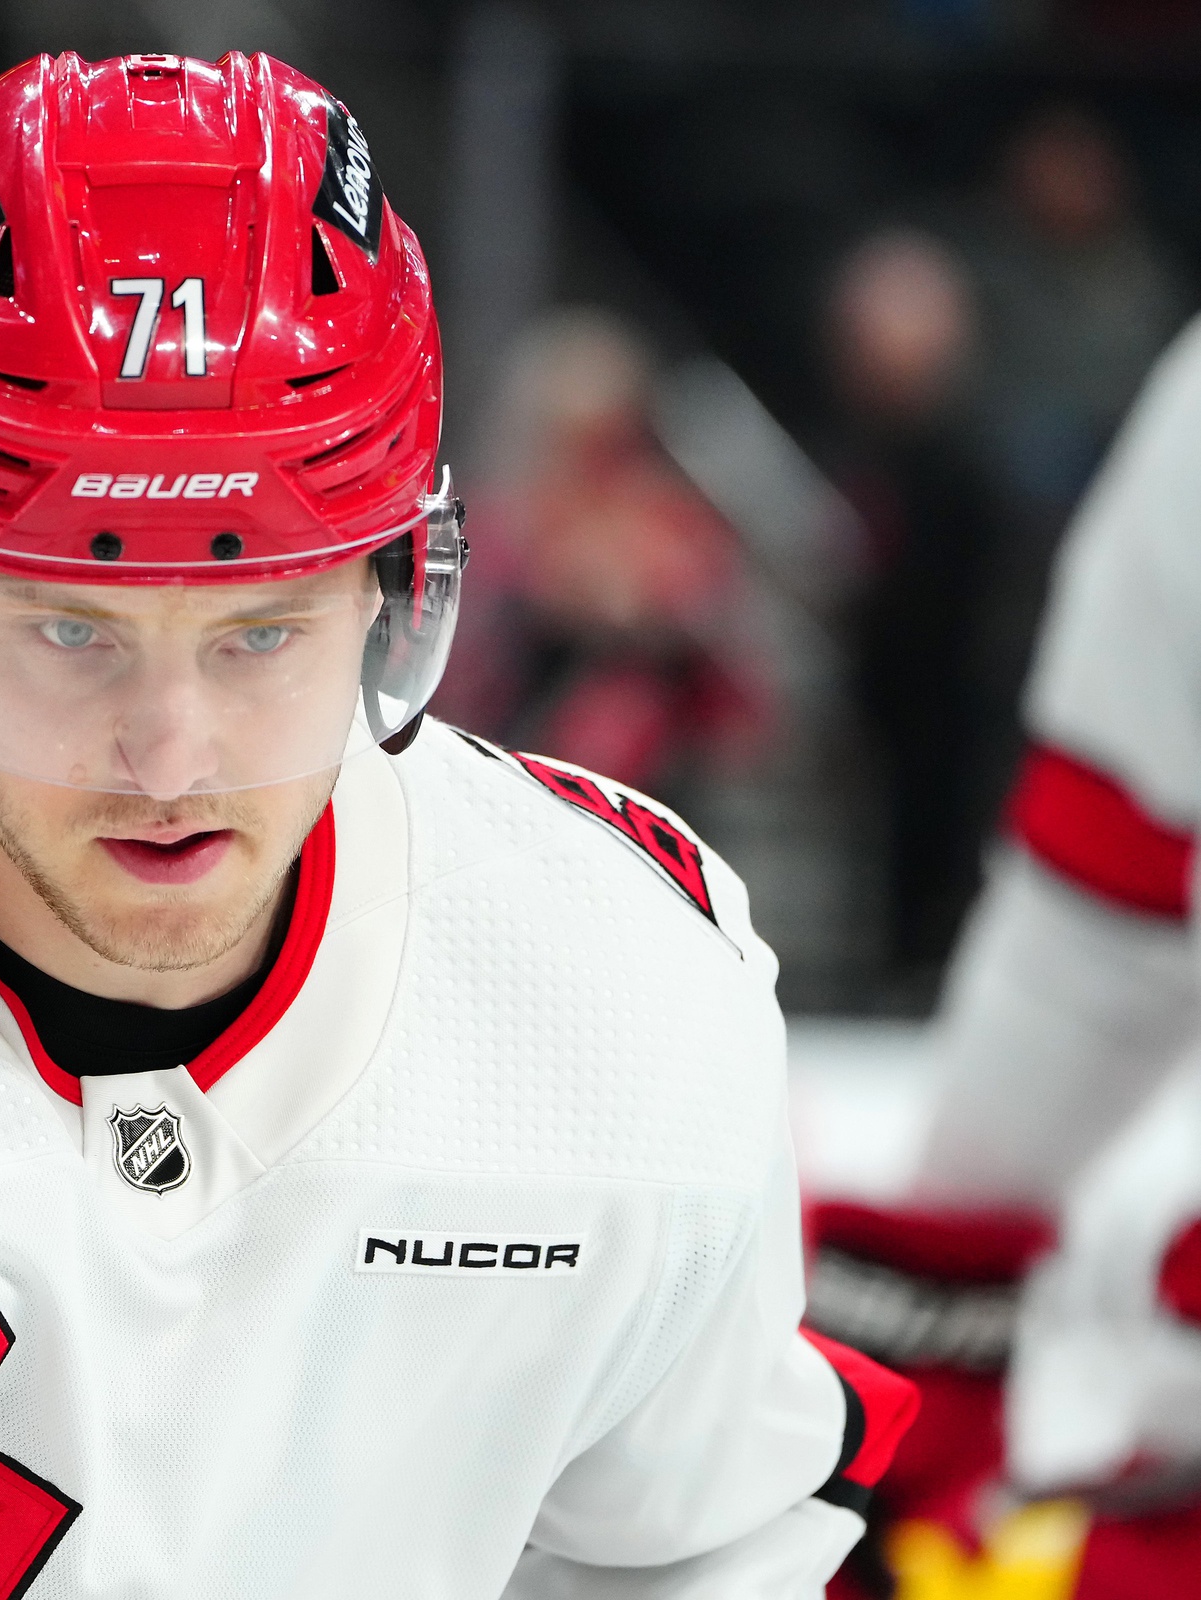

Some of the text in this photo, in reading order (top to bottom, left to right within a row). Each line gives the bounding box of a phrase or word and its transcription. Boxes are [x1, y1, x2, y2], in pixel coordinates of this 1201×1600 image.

[110, 277, 206, 378] 71
[131, 1127, 172, 1177] NHL
[364, 1237, 581, 1269] NUCOR
